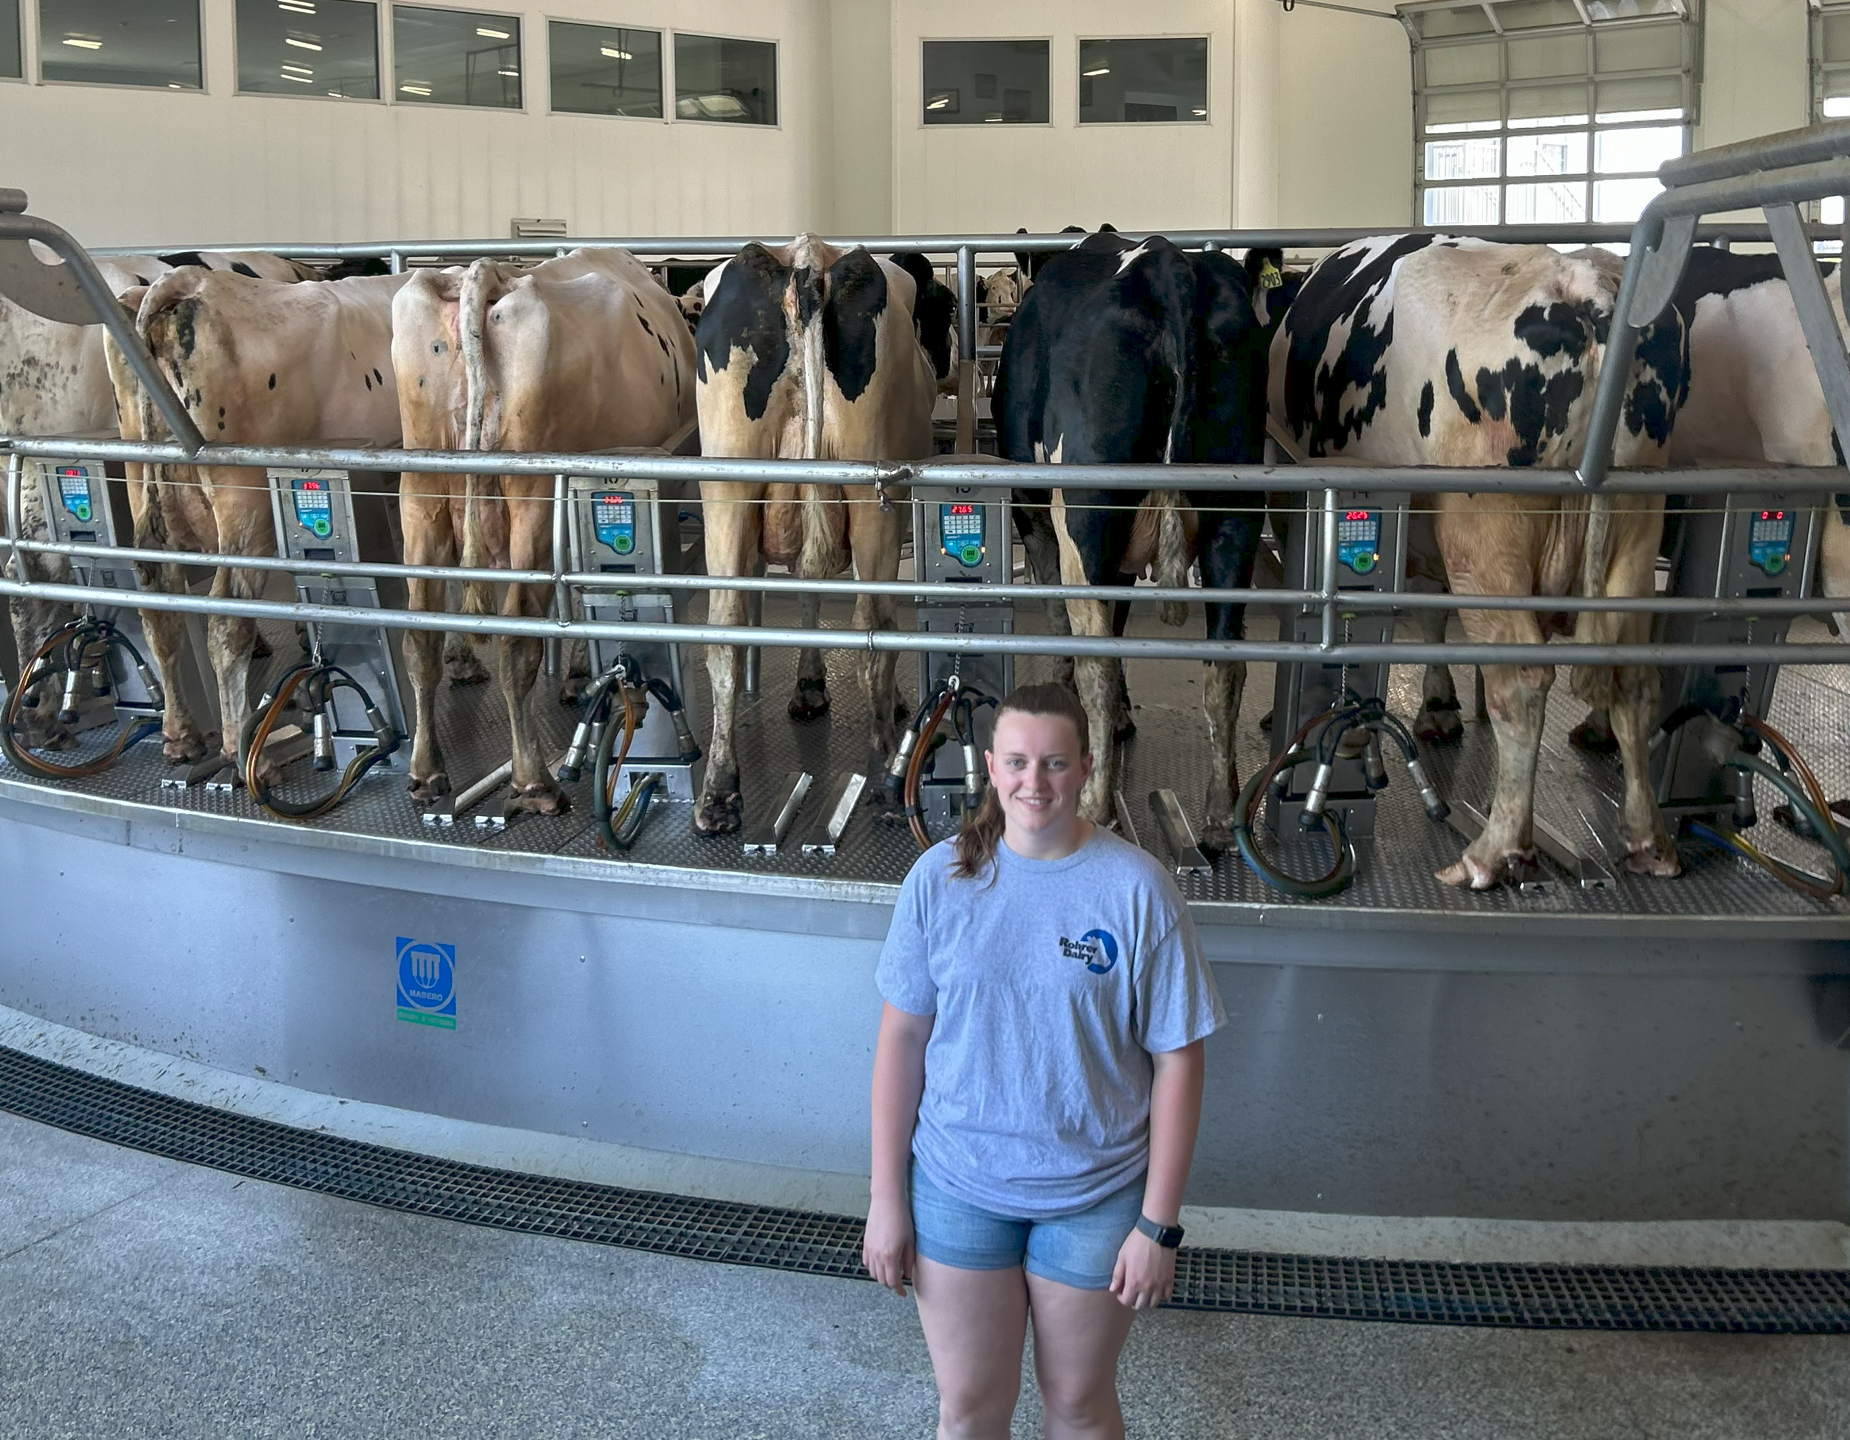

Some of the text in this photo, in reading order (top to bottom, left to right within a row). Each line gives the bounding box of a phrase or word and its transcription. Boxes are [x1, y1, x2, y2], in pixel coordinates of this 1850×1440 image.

[1059, 936, 1098, 954] Rohrer
[1063, 948, 1094, 965] Dairy
[409, 989, 443, 1002] MADERO
